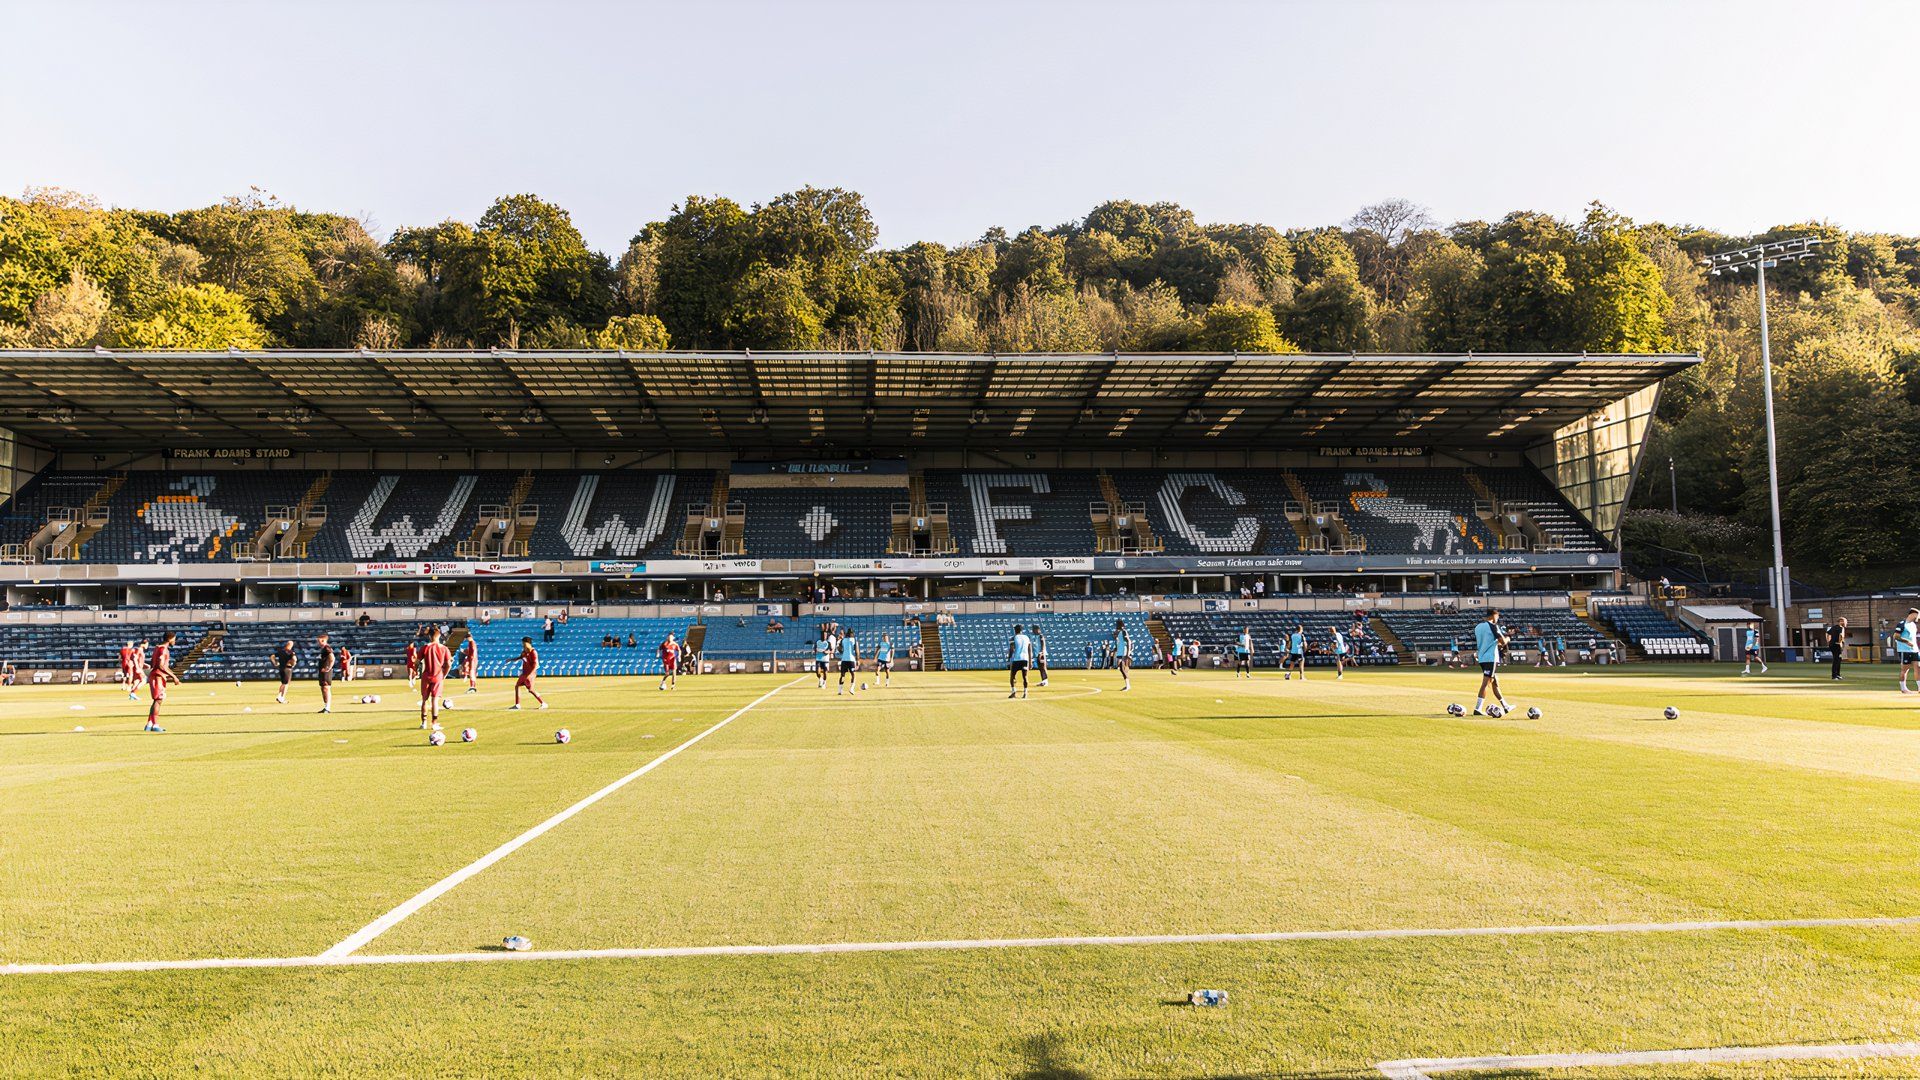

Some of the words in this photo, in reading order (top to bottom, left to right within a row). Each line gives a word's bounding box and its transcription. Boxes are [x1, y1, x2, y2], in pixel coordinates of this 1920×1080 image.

[174, 448, 210, 458] FRANK
[214, 448, 250, 458] ADAMS
[256, 448, 290, 458] STAND
[1320, 447, 1352, 456] FRANK
[1355, 447, 1388, 456] ADAMS
[1392, 447, 1423, 456] STAND
[1197, 559, 1225, 567] Season
[1226, 558, 1254, 567] Tickets
[1405, 557, 1423, 565] Visit
[1464, 556, 1477, 565] for
